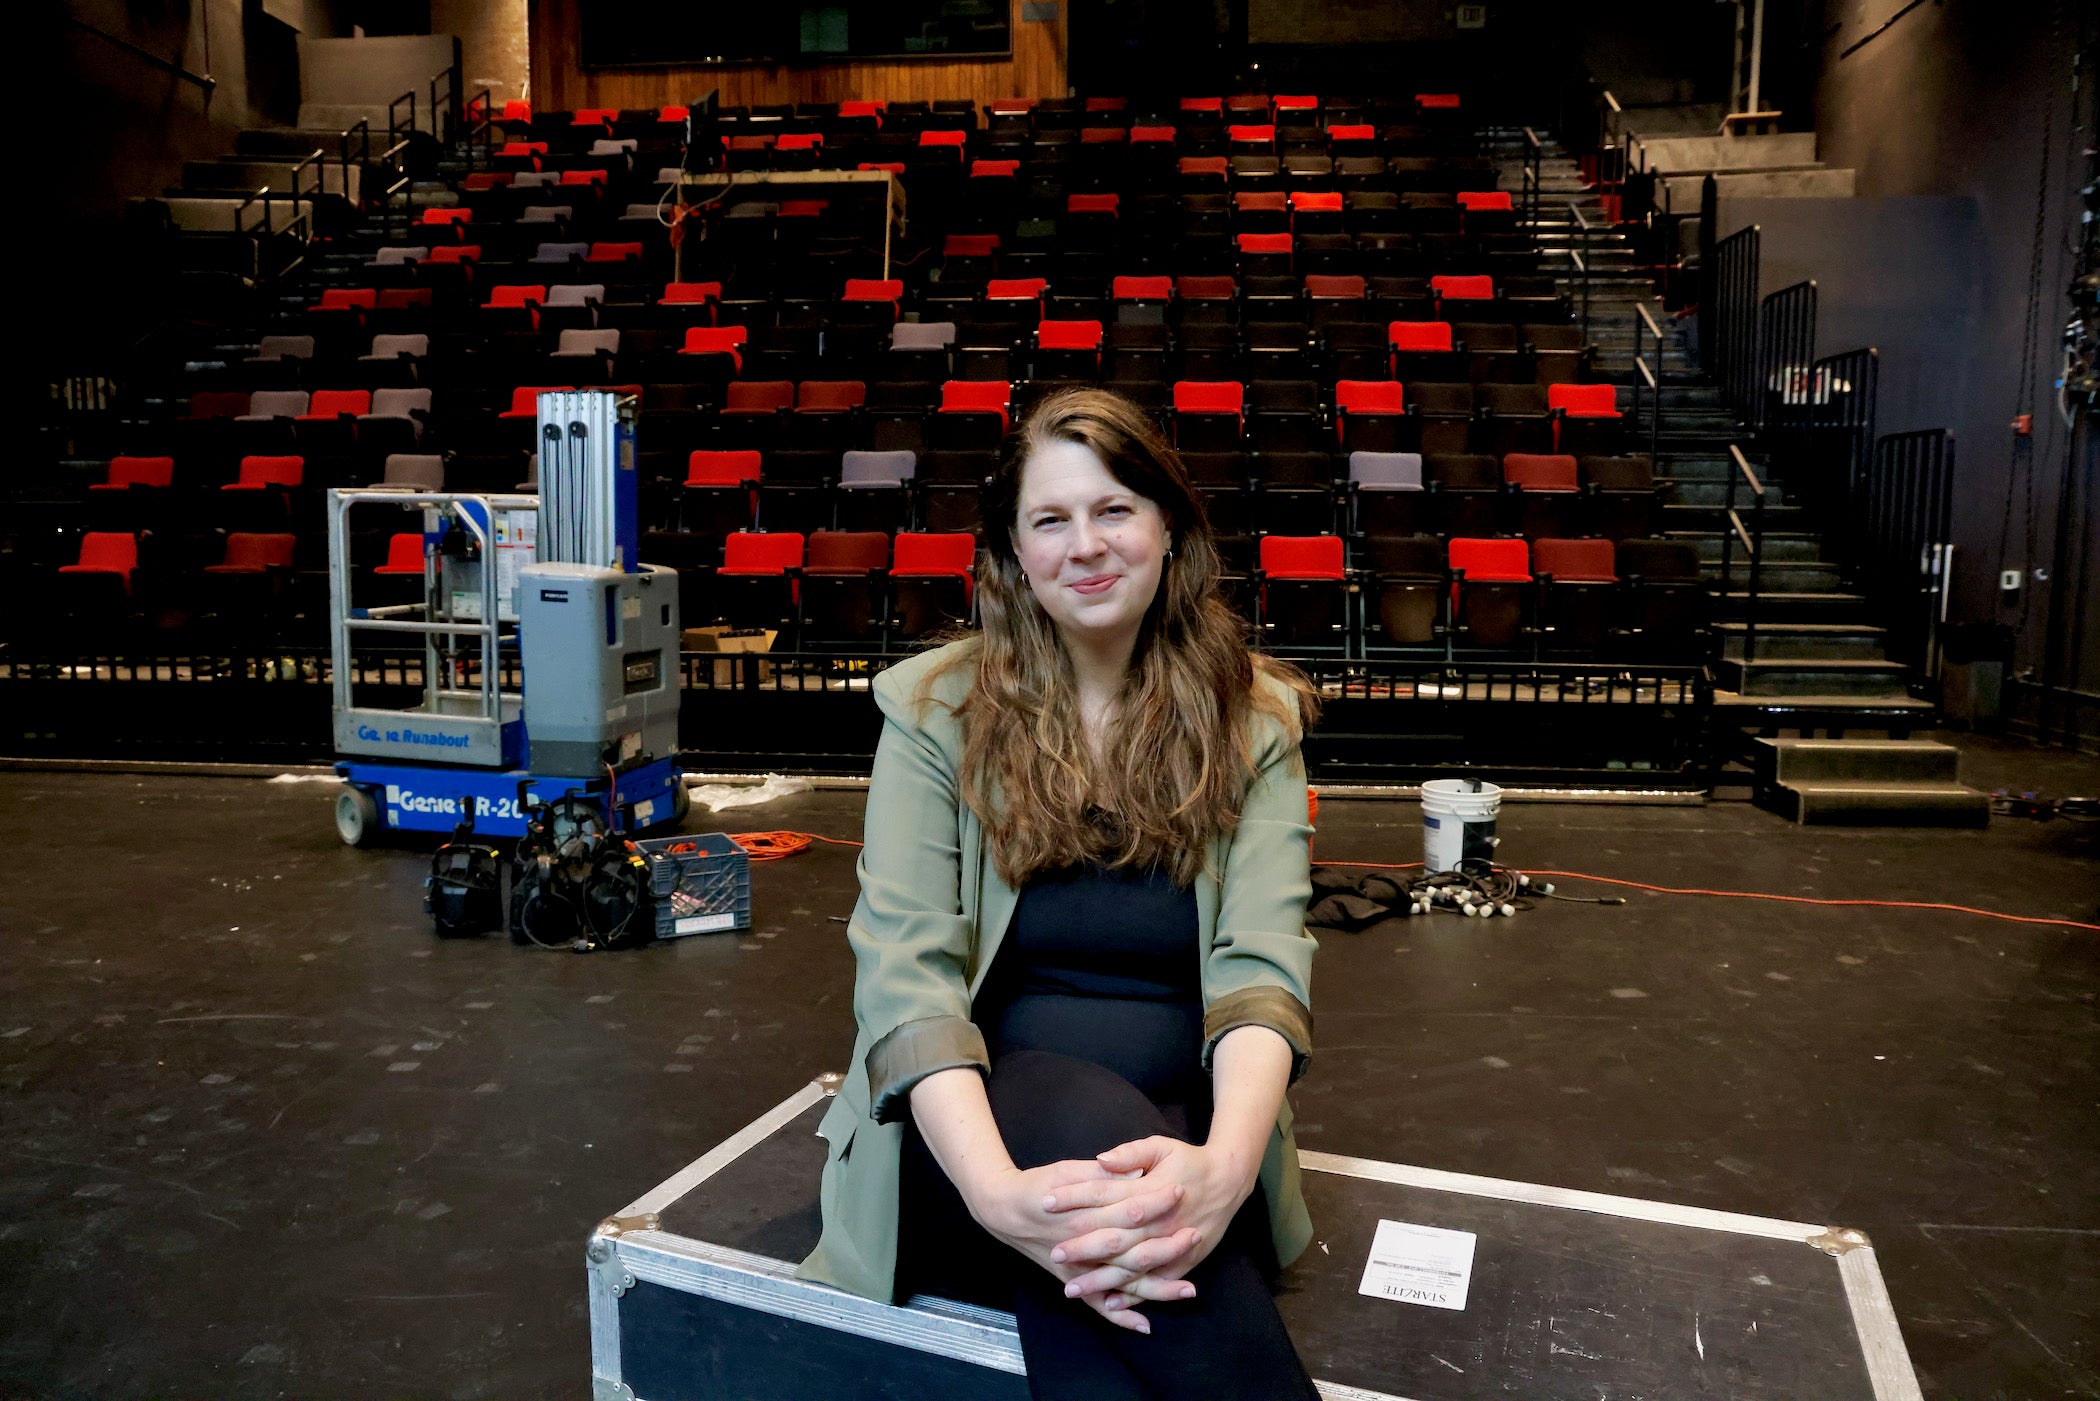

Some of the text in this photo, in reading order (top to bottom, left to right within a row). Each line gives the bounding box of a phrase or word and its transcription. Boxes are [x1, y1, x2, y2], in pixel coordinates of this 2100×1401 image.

[358, 725, 469, 747] Geie Runabout
[400, 791, 456, 814] Genie
